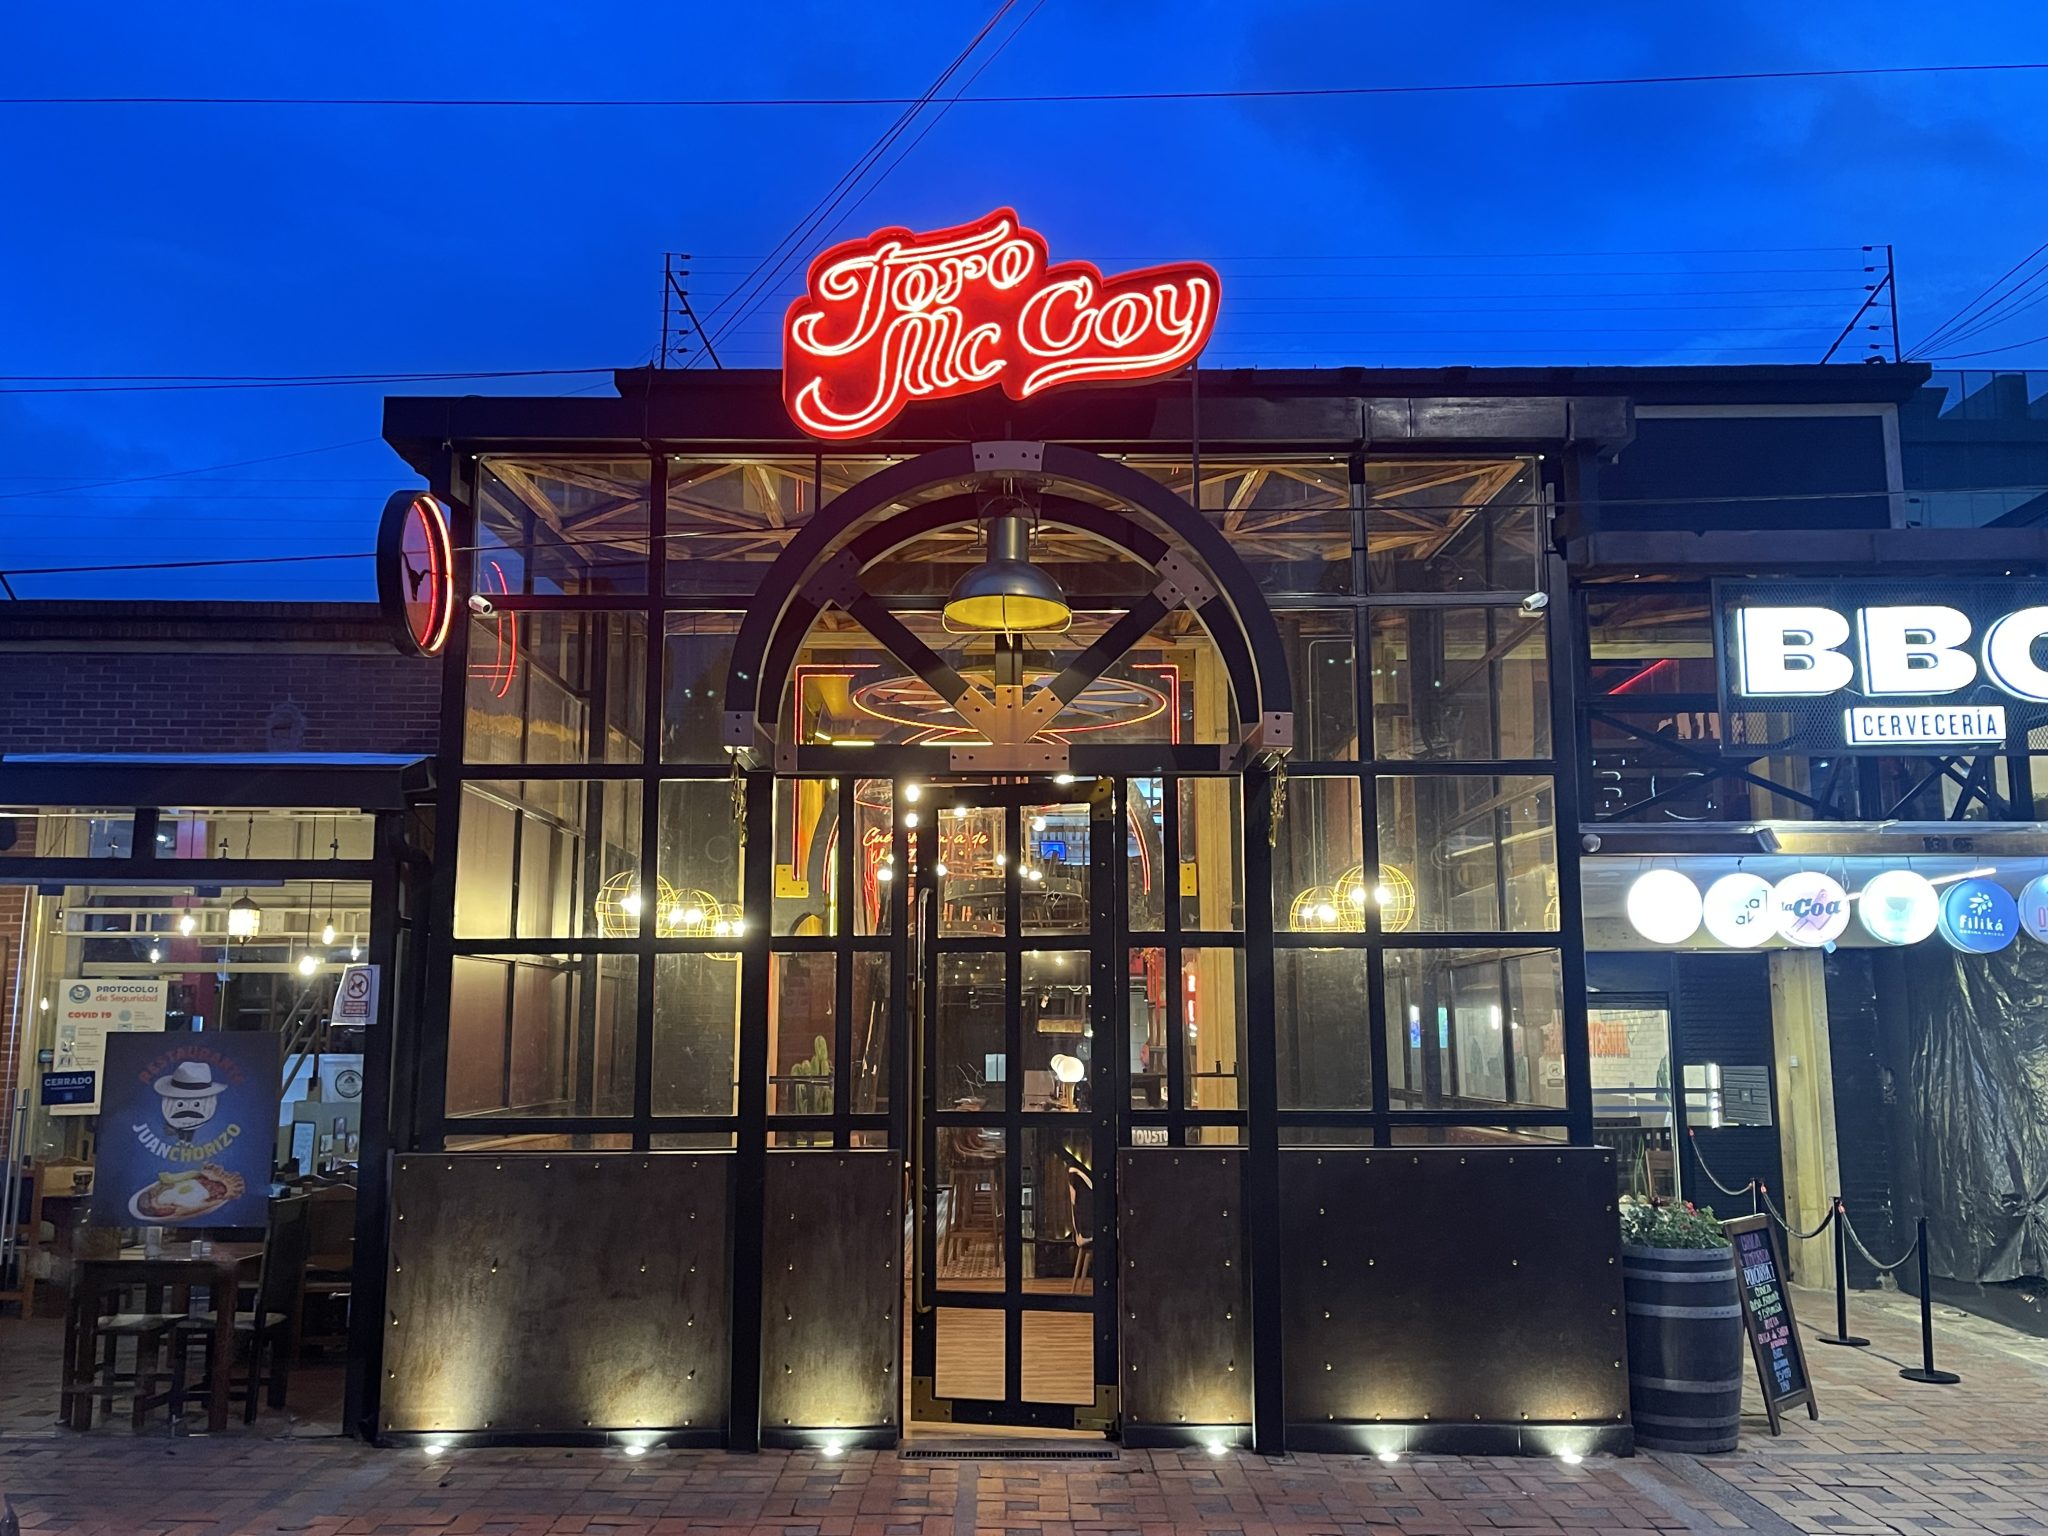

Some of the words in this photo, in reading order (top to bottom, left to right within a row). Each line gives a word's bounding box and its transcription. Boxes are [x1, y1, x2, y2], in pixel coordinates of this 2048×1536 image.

[792, 218, 1036, 357] Toro
[795, 305, 1007, 433] Mc
[1017, 275, 1211, 397] Coy
[1862, 708, 1998, 737] CERVECERÍA
[1793, 897, 1841, 918] Coa
[110, 993, 158, 1003] Seguridad
[67, 1011, 99, 1019] COVID
[101, 1011, 113, 1019] 19
[44, 1076, 93, 1087] CERRADO
